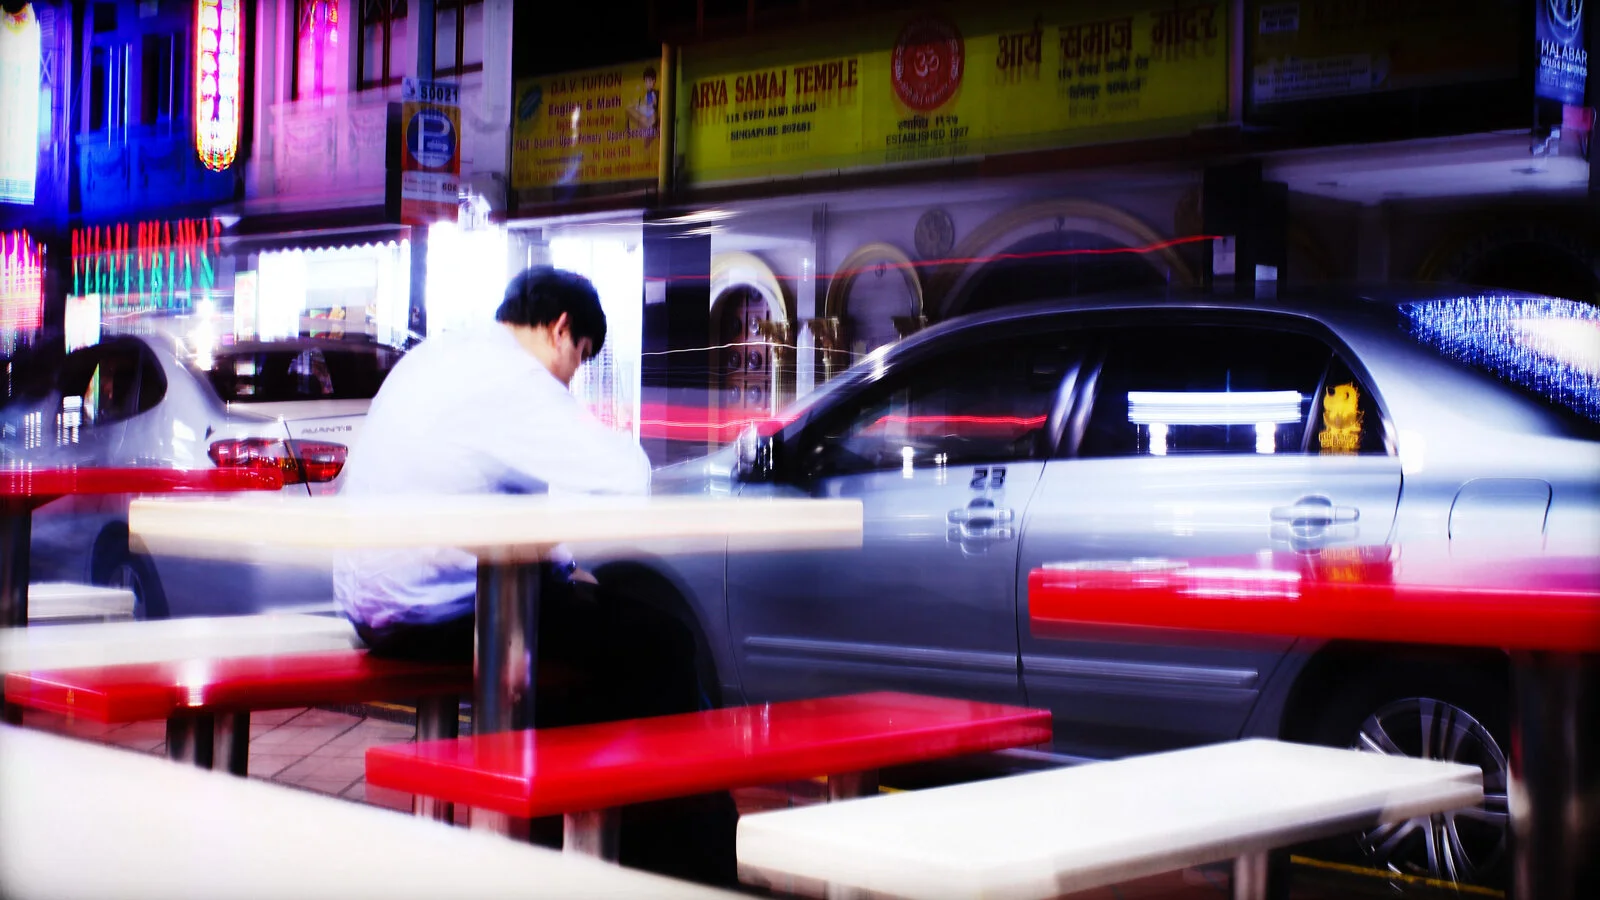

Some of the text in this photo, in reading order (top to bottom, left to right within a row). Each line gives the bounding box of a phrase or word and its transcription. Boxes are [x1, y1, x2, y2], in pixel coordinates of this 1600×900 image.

[1541, 38, 1587, 65] MALABAR
[582, 72, 623, 92] TUITION
[690, 59, 858, 109] ARYA SAMAJ TEMPLE
[768, 105, 789, 118] ALWI
[792, 102, 817, 115] ROAD
[731, 124, 779, 140] SINGAPORE
[886, 129, 946, 145] ESTABLISHED
[970, 466, 1006, 490] 23
